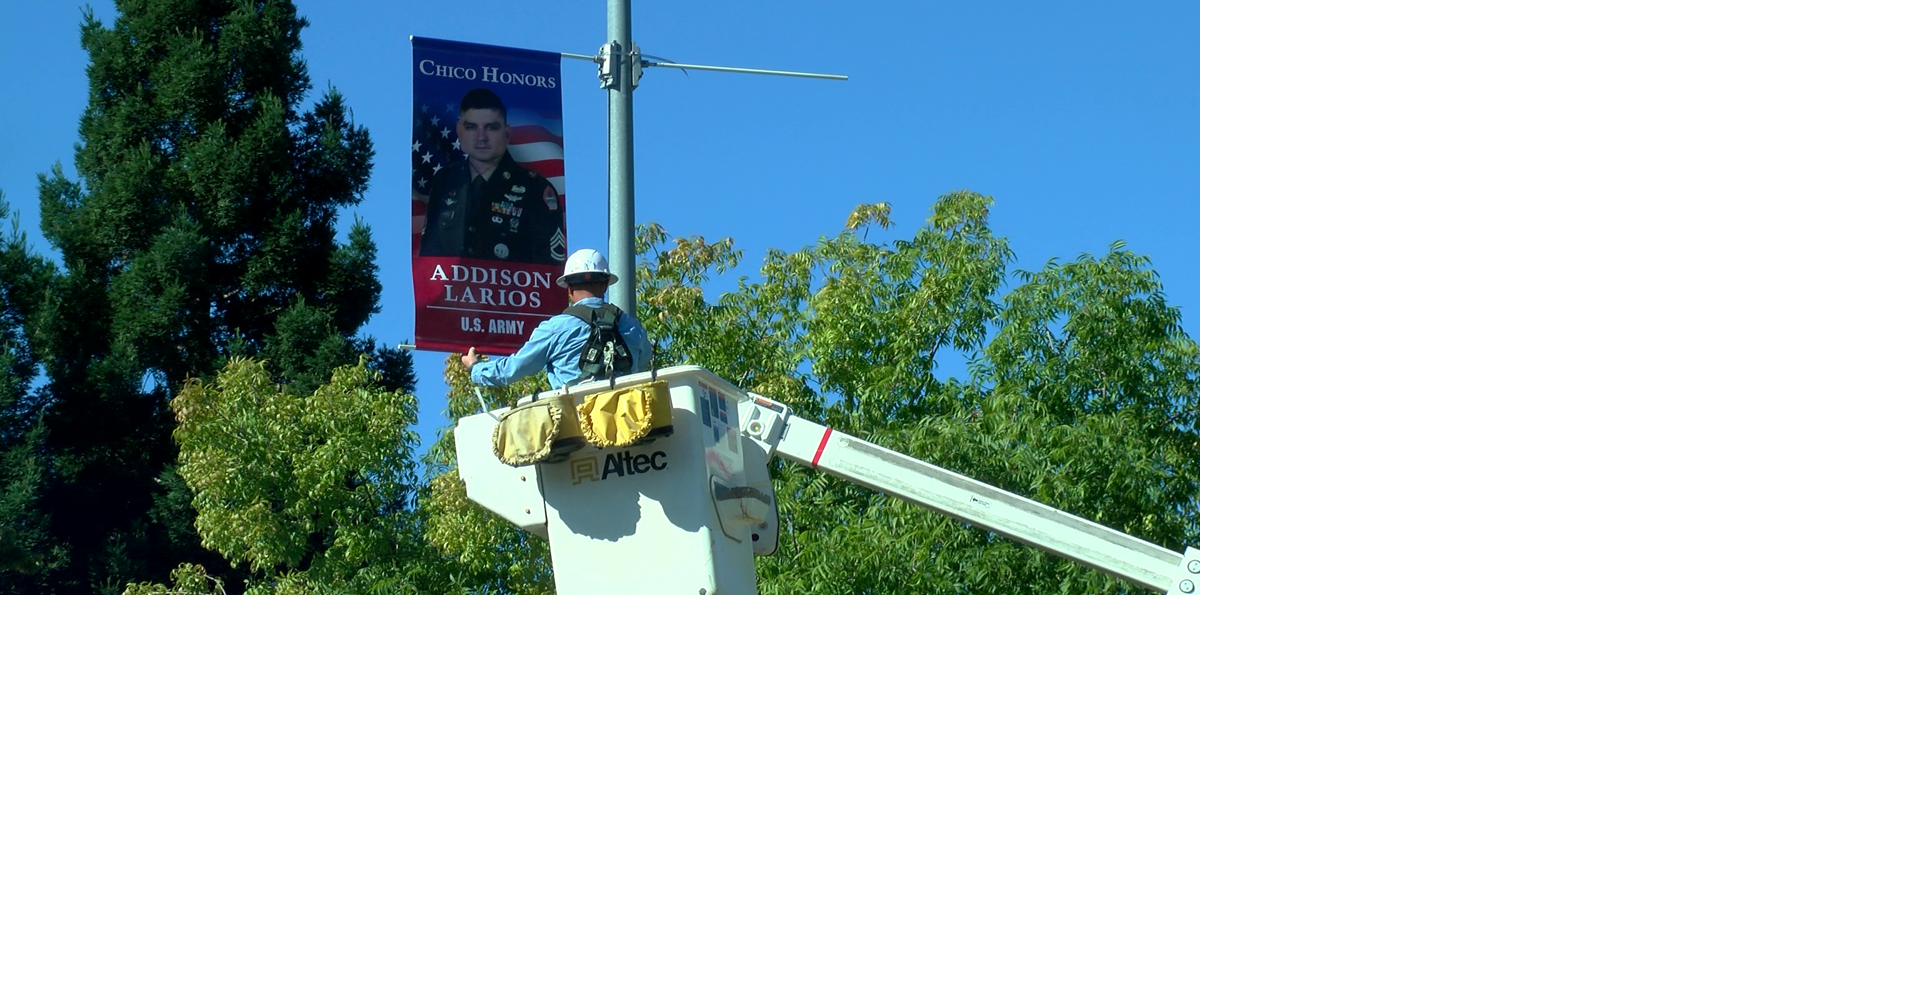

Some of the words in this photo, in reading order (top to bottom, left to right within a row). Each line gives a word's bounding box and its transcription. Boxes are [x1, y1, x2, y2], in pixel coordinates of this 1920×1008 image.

[419, 59, 477, 80] CHICO
[481, 66, 556, 88] HONORS
[430, 264, 551, 289] ADDISON
[444, 284, 541, 308] LARIOS
[460, 316, 485, 333] U.S.
[488, 318, 525, 335] ARMY
[601, 450, 668, 480] Altec
